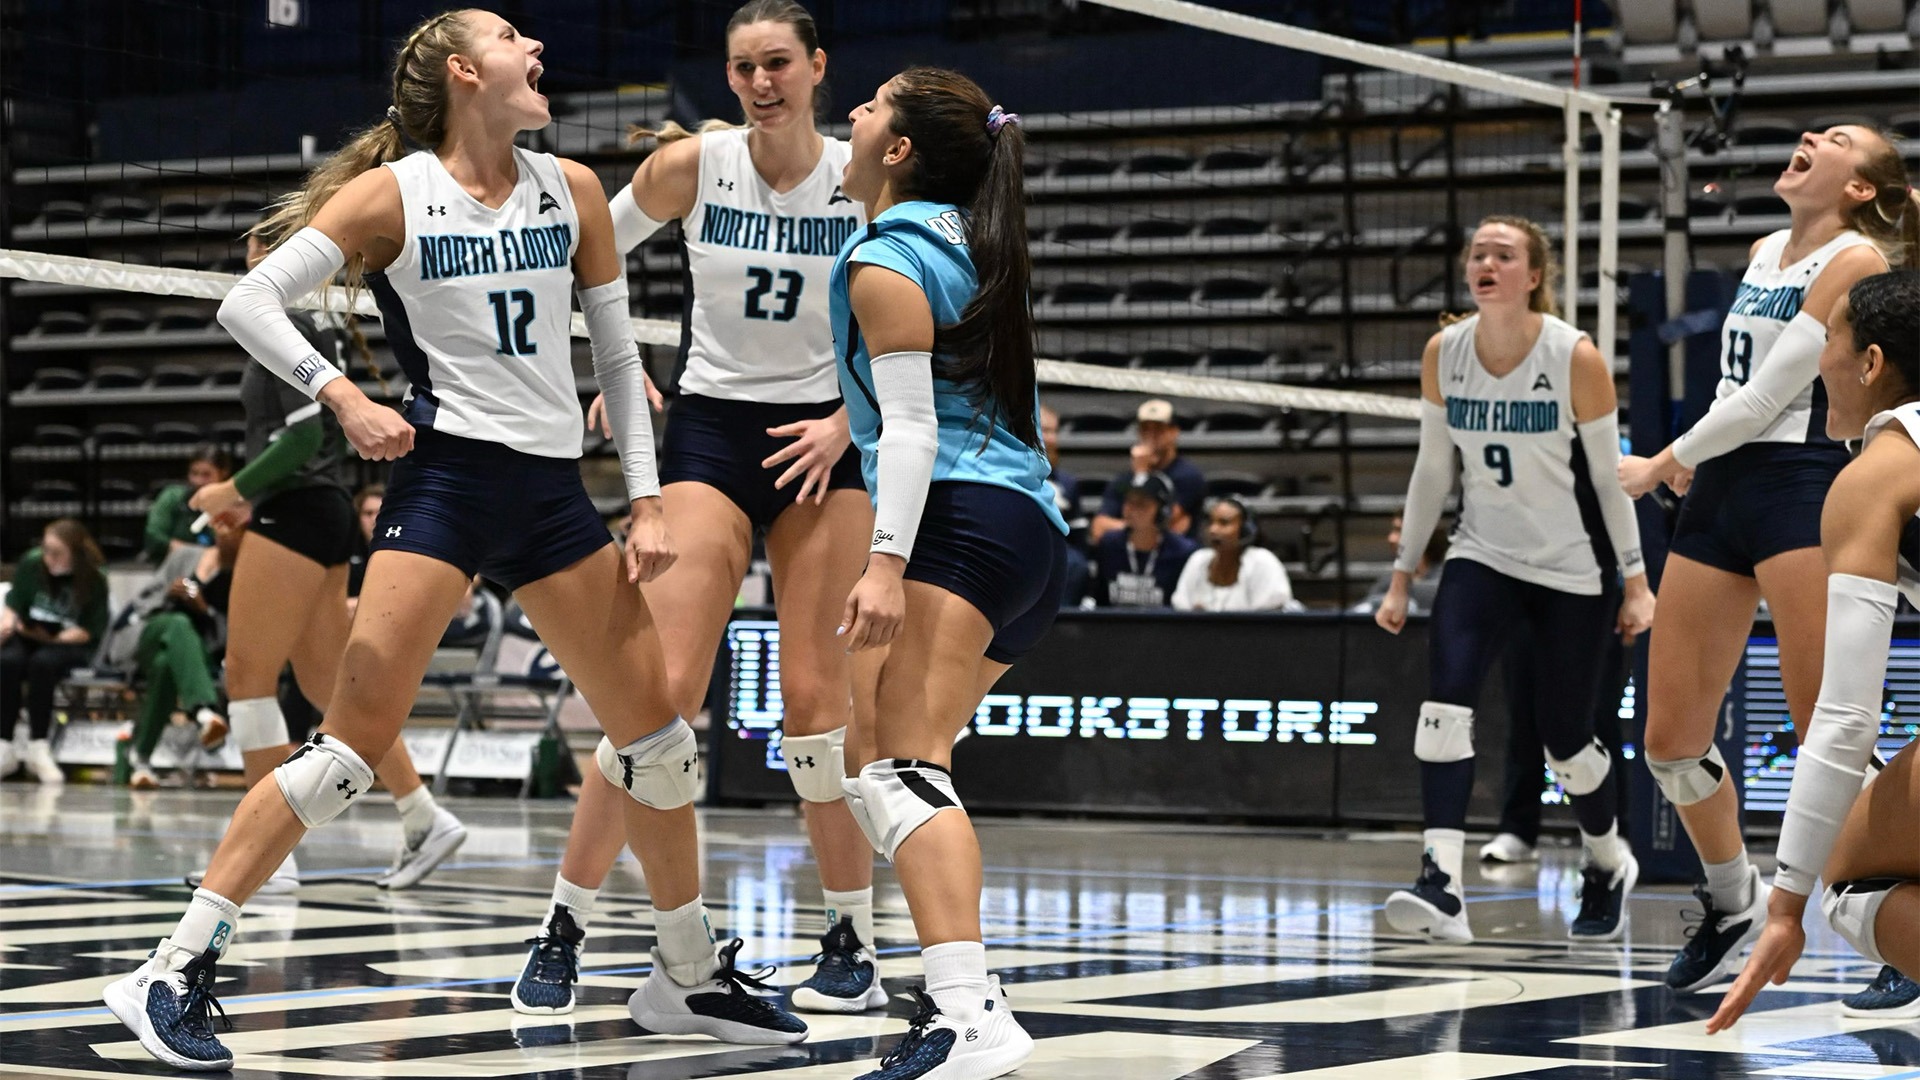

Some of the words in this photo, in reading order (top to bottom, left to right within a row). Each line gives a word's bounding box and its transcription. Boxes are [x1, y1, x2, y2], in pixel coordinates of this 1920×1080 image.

[699, 202, 771, 251] NORTH
[417, 234, 498, 281] NORTH
[744, 265, 805, 323] 23
[487, 288, 537, 357] 12
[1724, 329, 1753, 387] 13
[1493, 400, 1559, 433] FLORIDA
[1484, 443, 1513, 488] 9
[974, 694, 1379, 745] OOKSTORE
